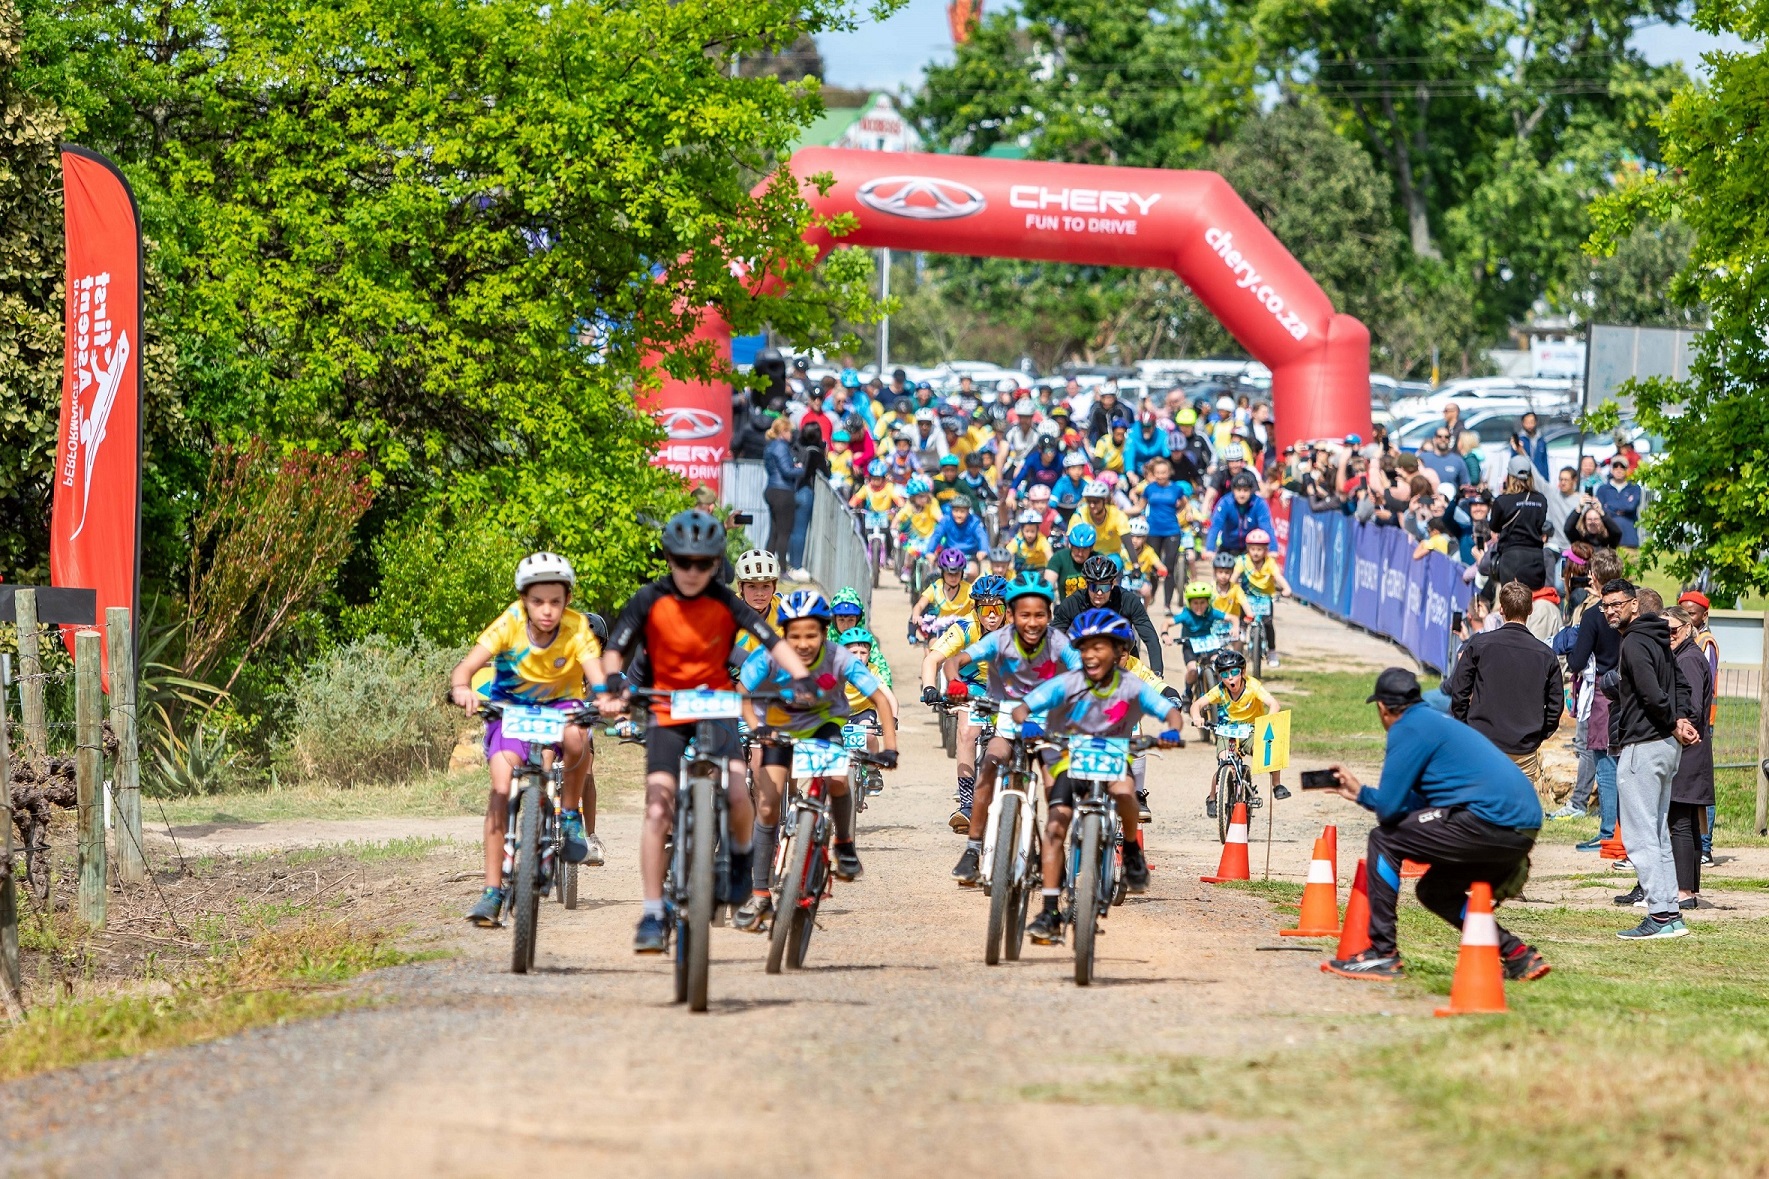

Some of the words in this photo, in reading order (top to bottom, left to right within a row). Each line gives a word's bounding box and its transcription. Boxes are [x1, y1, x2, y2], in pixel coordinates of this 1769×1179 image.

[1009, 185, 1162, 216] CHERY
[1025, 214, 1059, 231] FUN
[1062, 216, 1086, 232] TO
[1087, 218, 1138, 236] DRIVE
[1204, 226, 1310, 341] chery.co.za
[648, 445, 725, 463] HERY
